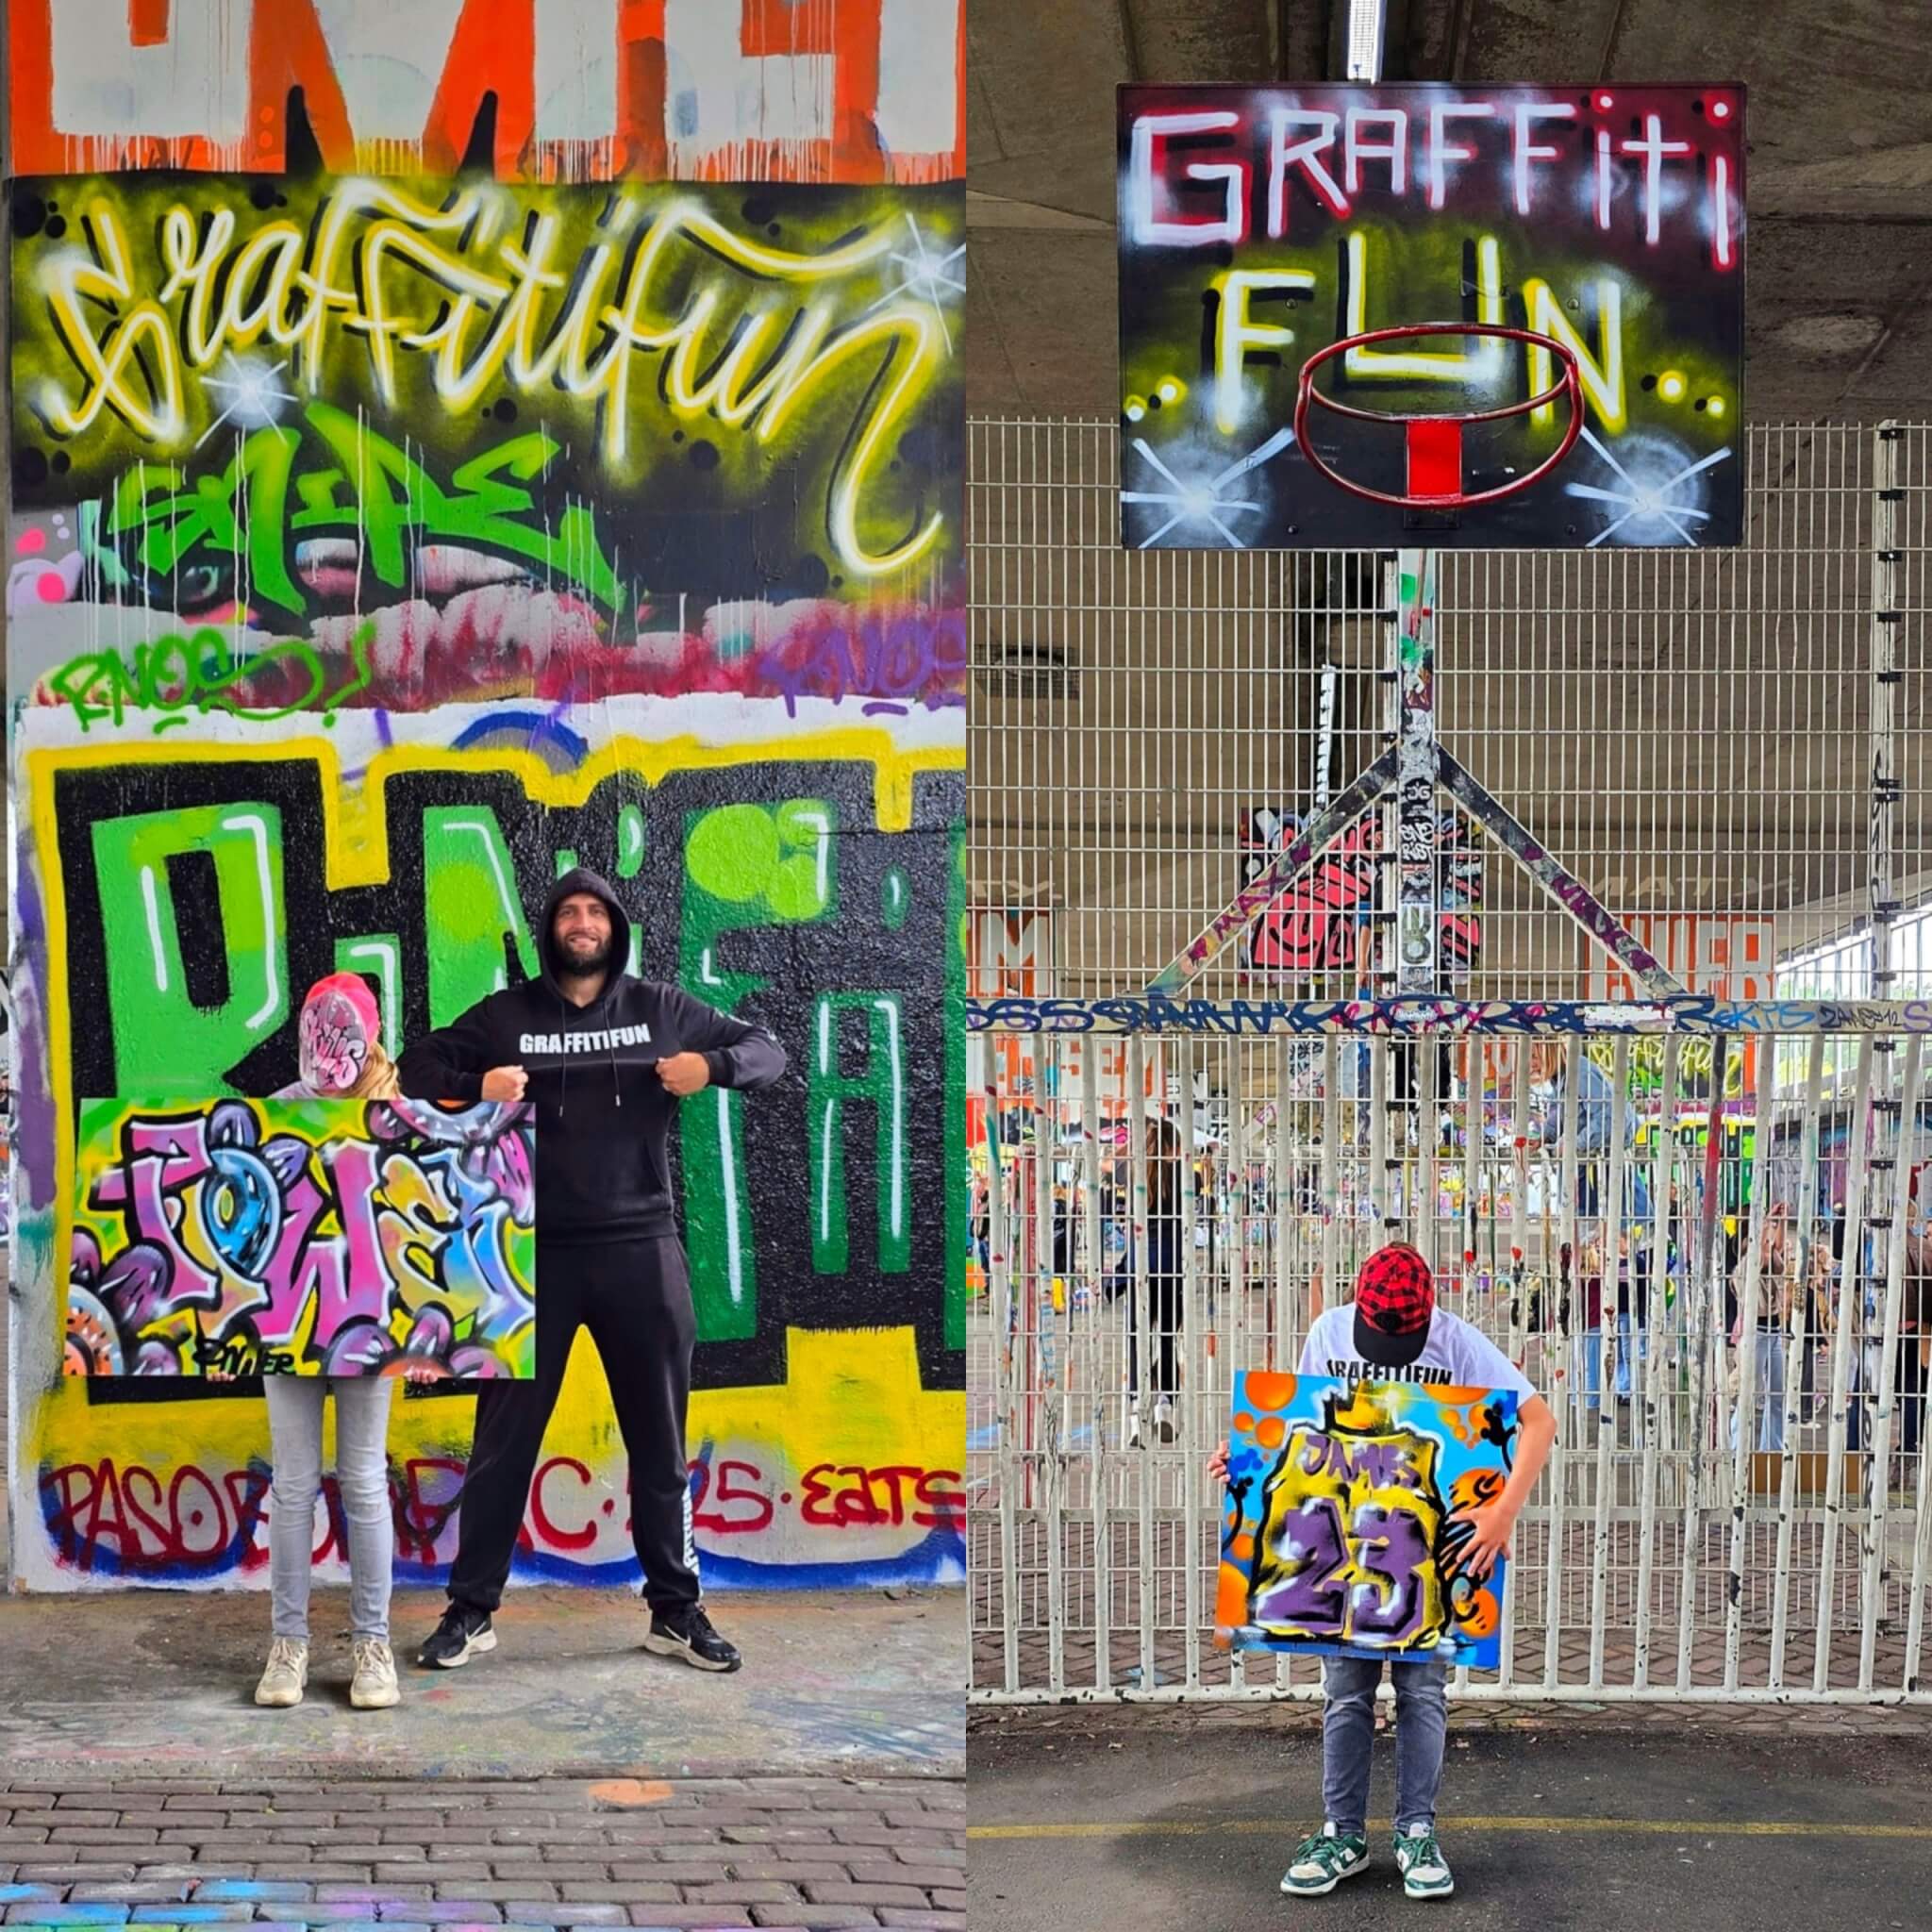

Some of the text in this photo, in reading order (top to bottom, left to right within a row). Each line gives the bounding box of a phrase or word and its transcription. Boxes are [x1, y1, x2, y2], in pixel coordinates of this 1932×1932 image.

[1211, 230, 1628, 433] FUN
[519, 1023, 652, 1055] GRAFFITIFUN
[1256, 1497, 1424, 1642] 23
